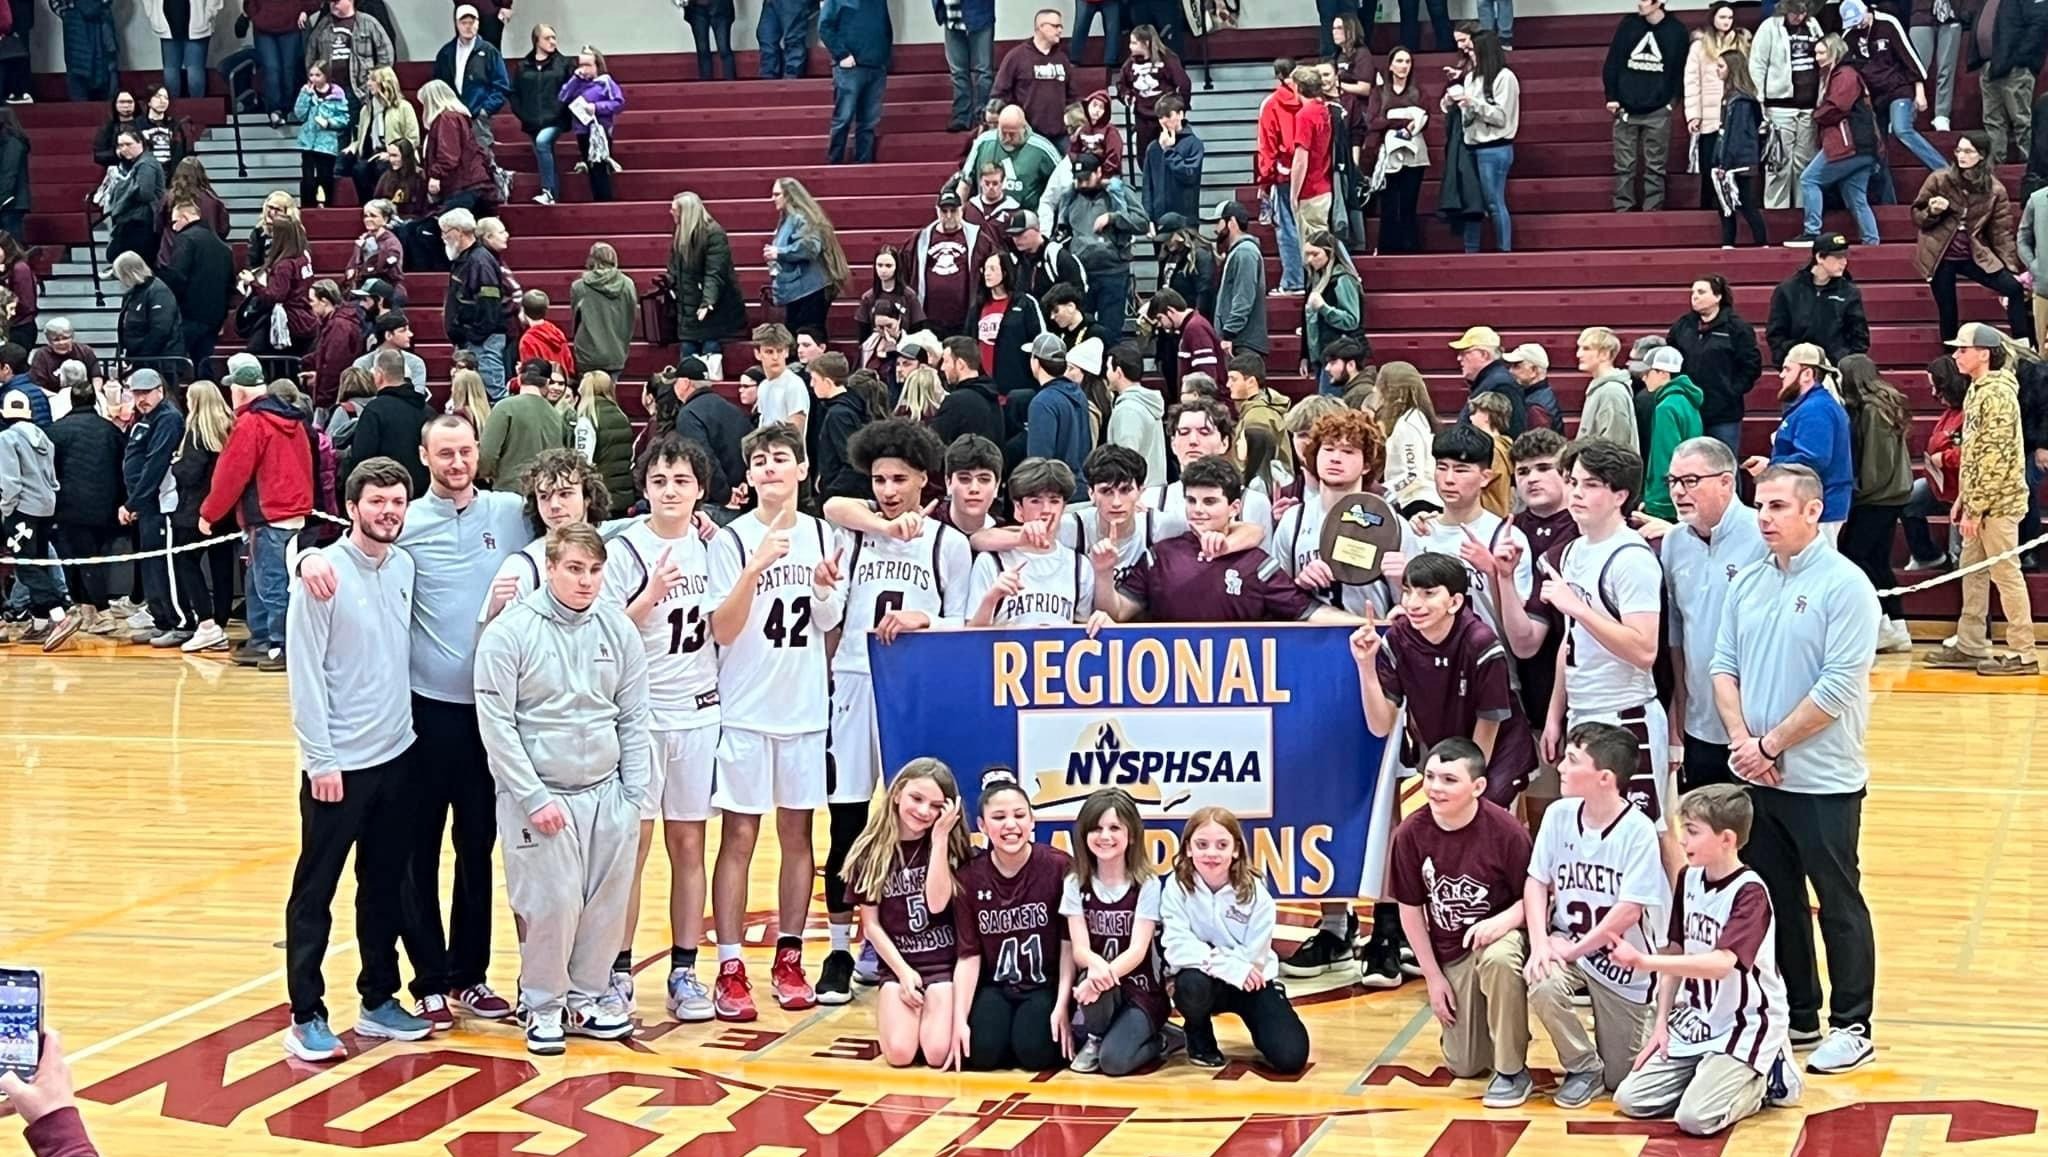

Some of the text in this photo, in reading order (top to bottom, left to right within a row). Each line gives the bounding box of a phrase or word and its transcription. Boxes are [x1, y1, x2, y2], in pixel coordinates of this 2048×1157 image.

[756, 565, 813, 595] PATRIOT
[857, 560, 931, 590] PATRIOTS
[763, 596, 812, 649] 42
[1007, 593, 1073, 621] PATRIOTS
[667, 605, 707, 655] 13
[992, 638, 1291, 707] REGIONAL
[1065, 749, 1262, 786] NYSPHSAA
[906, 895, 929, 932] 5
[978, 902, 1049, 934] SACKETS
[1083, 909, 1134, 936] ACKET
[993, 933, 1047, 984] 41
